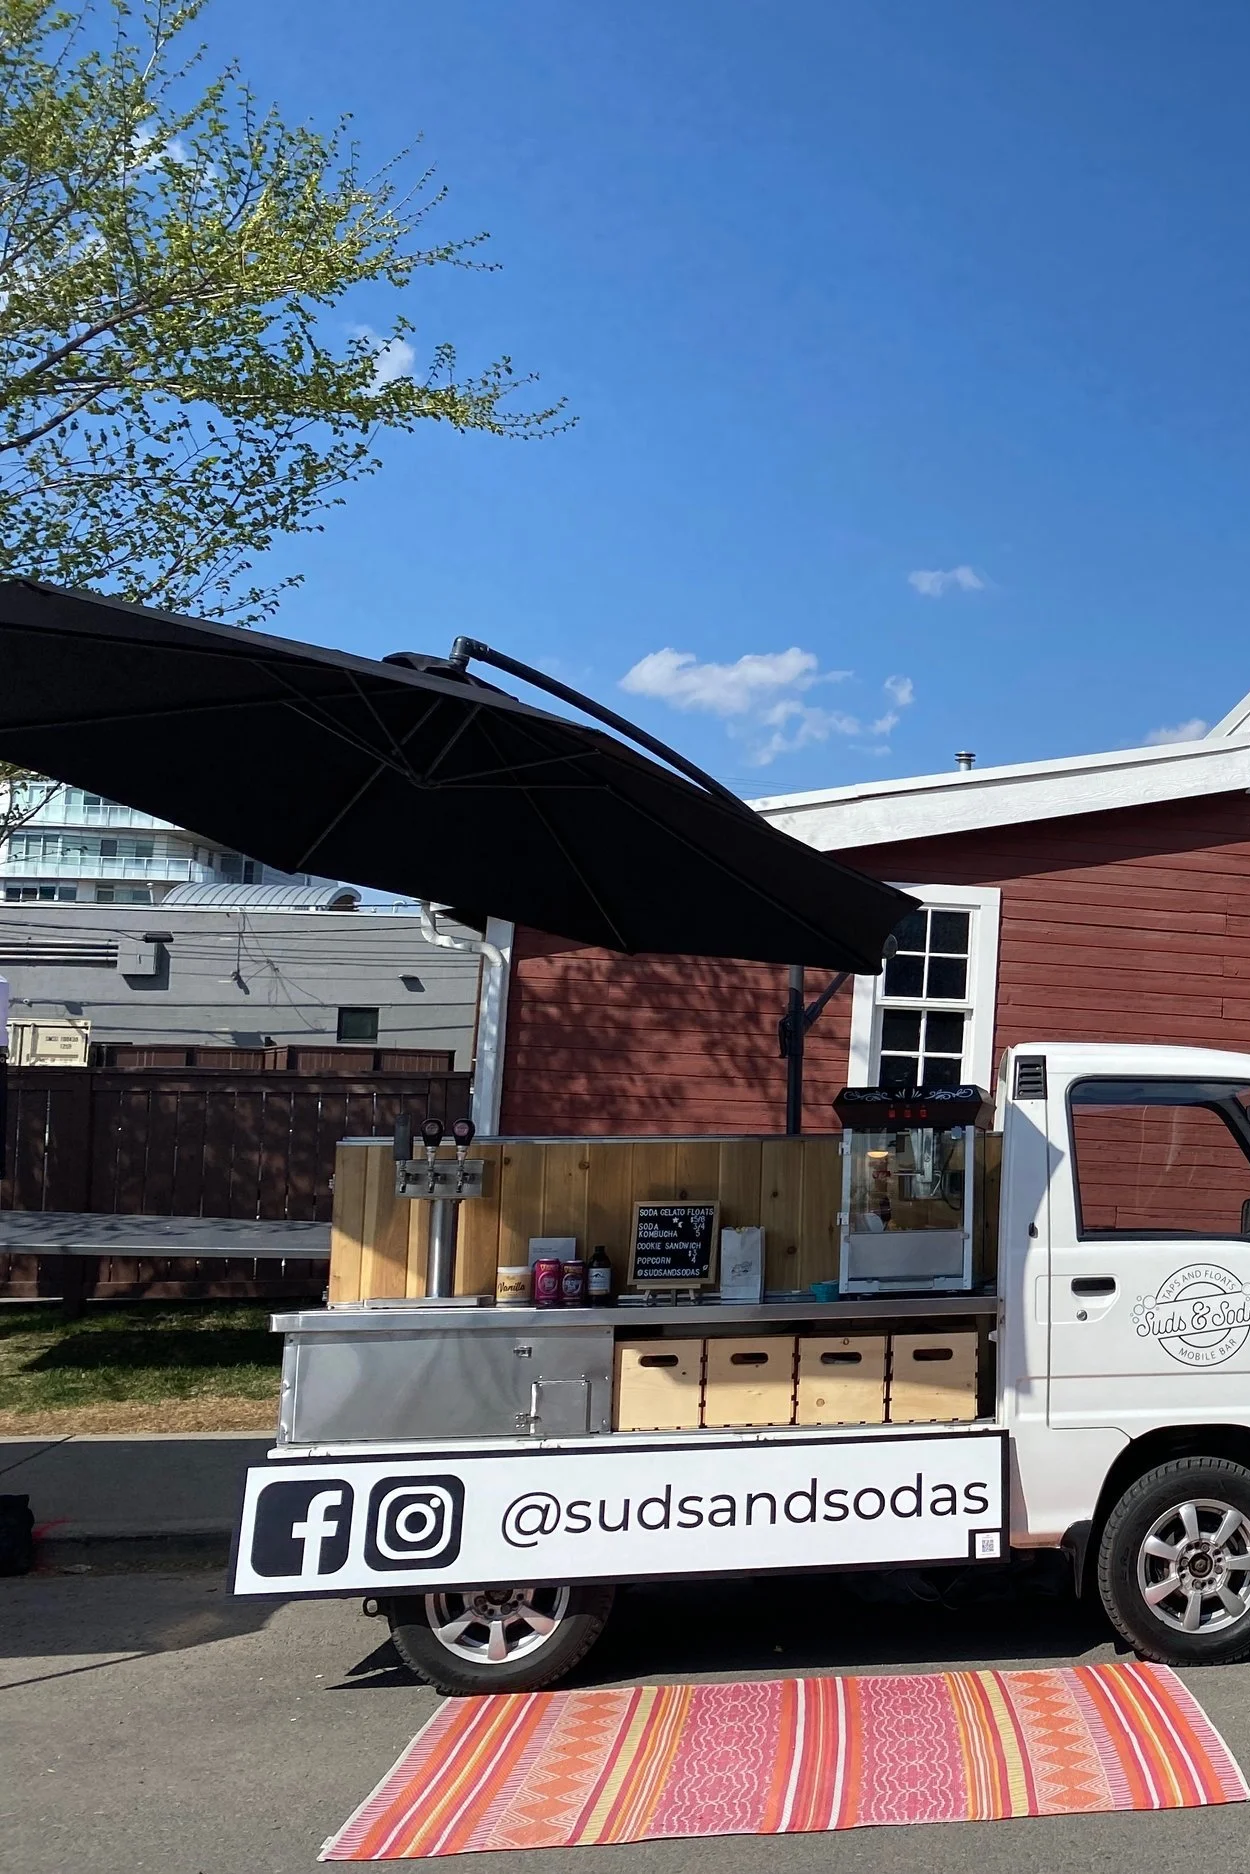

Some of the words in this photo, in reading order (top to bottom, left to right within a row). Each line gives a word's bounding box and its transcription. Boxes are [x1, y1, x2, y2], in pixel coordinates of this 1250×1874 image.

[640, 1208, 658, 1216] SODA
[660, 1208, 685, 1216] GELATO
[687, 1208, 714, 1216] FLOATS
[638, 1223, 659, 1231] SODA
[637, 1242, 661, 1250] COOKIE
[664, 1242, 701, 1250] SANDWICH
[637, 1257, 671, 1265] POPCORN
[1161, 1279, 1181, 1300] TAPS
[1182, 1269, 1202, 1283] AND
[1204, 1269, 1237, 1291] FLOATS
[1136, 1311, 1187, 1338] Suds
[1191, 1301, 1211, 1331] &
[1178, 1347, 1216, 1361] MOBILE
[1218, 1338, 1238, 1356] BAR
[500, 1472, 990, 1548] @sudsandsodas
